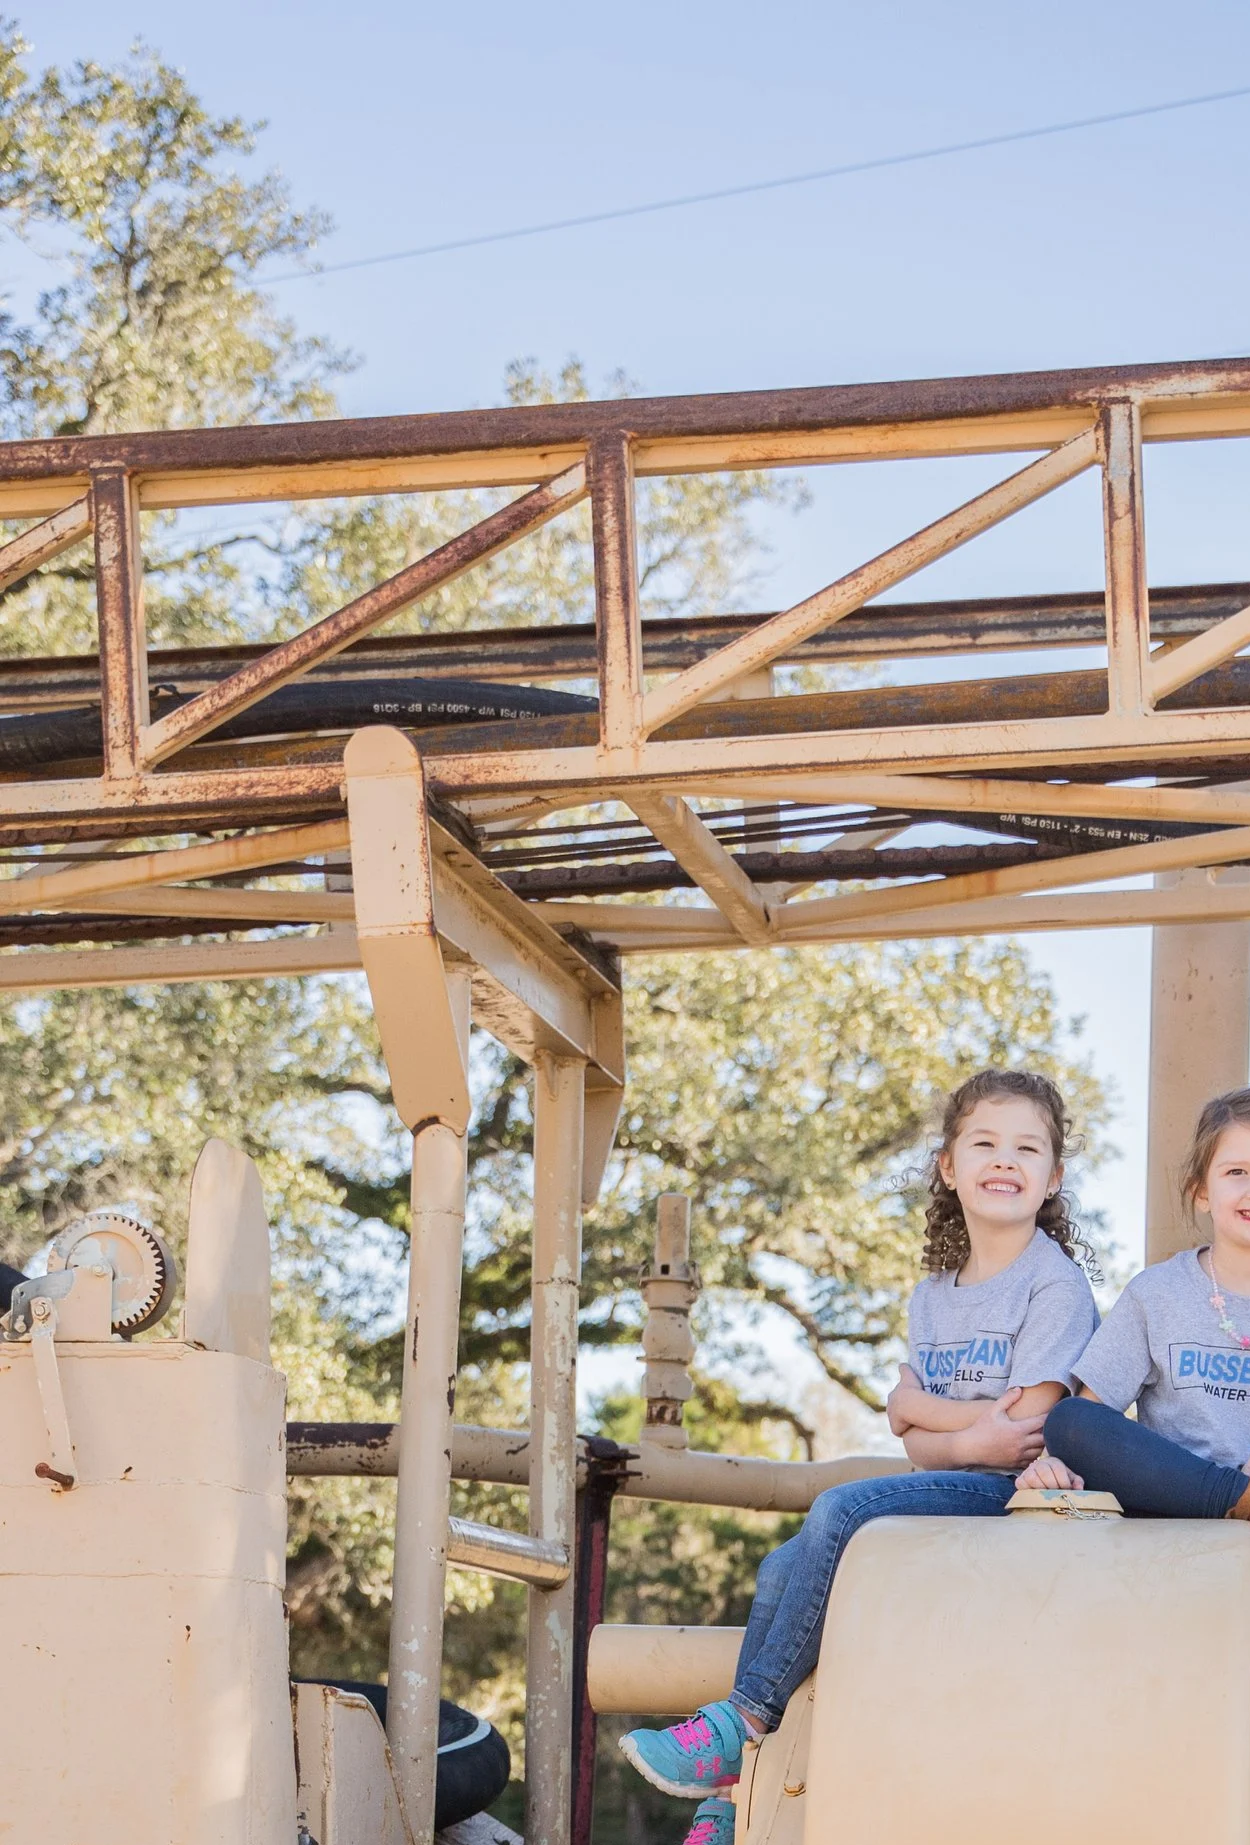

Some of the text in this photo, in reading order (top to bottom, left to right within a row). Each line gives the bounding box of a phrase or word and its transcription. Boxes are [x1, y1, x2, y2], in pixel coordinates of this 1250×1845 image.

[408, 703, 422, 712] BP
[478, 706, 495, 716] WP
[1107, 830, 1121, 840] EN
[1204, 1383, 1247, 1401] WATER
